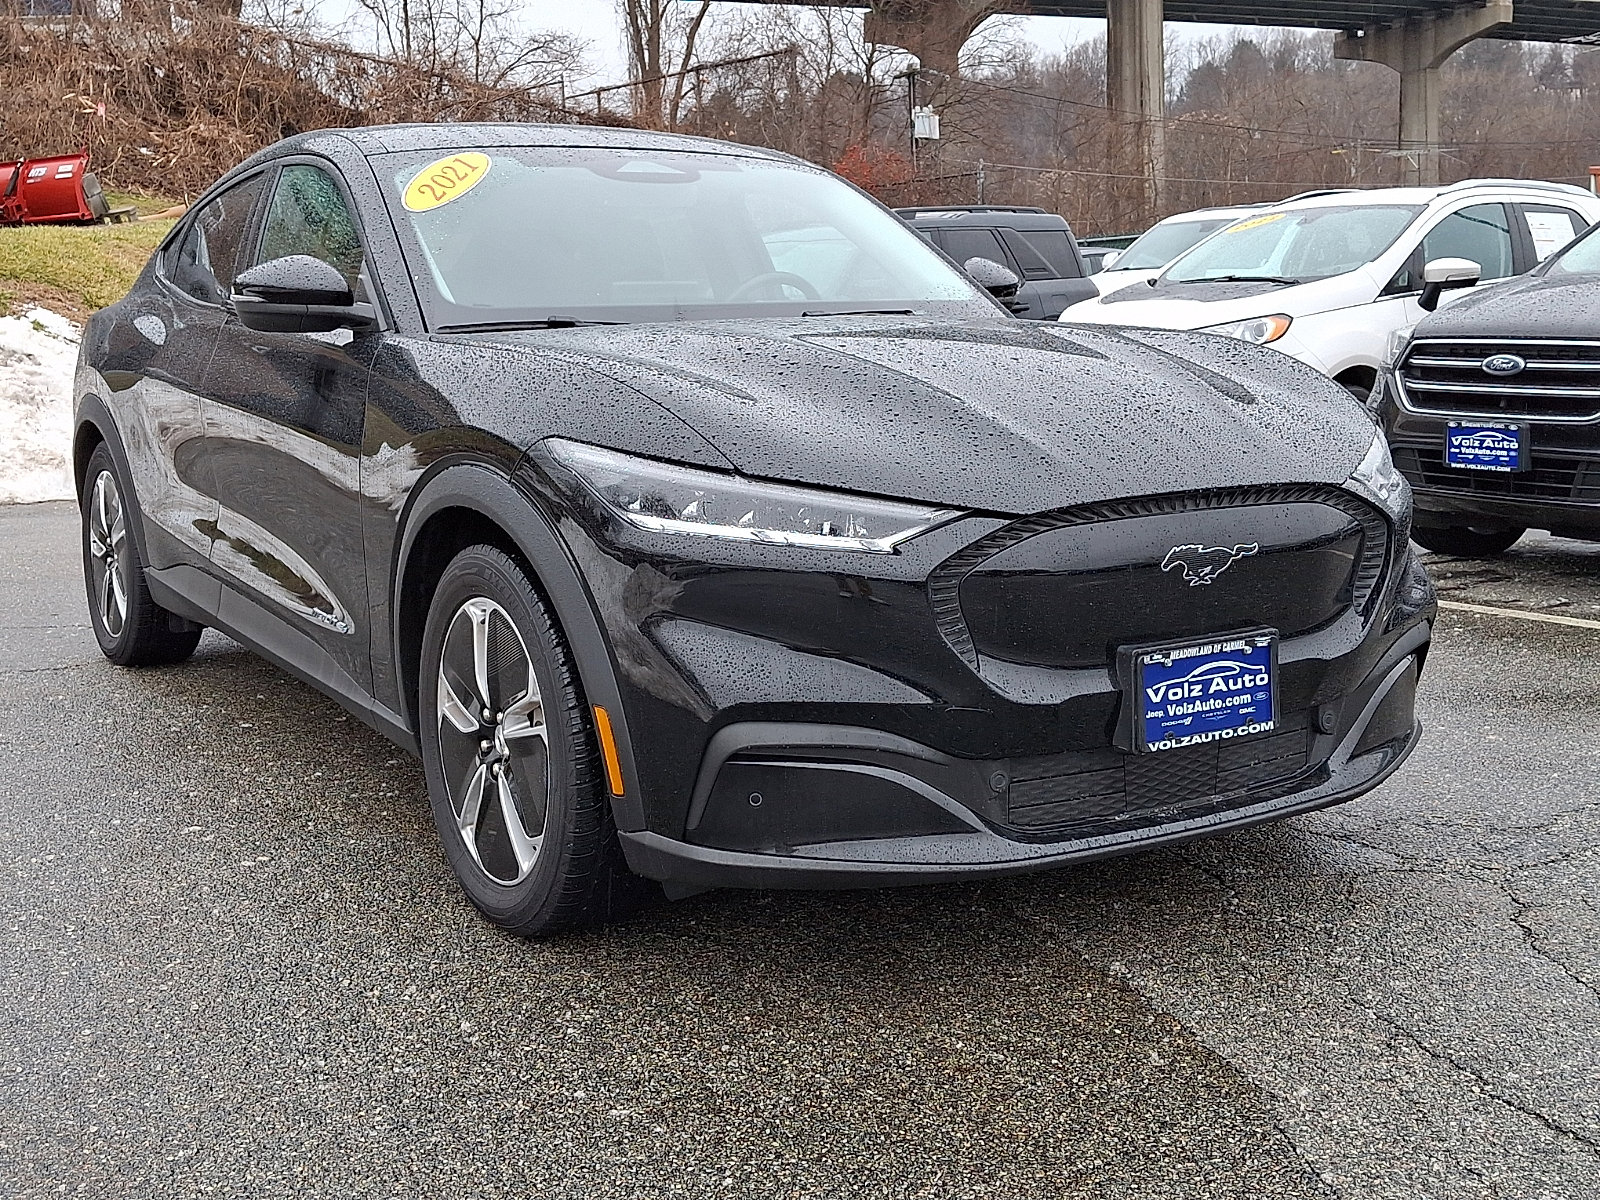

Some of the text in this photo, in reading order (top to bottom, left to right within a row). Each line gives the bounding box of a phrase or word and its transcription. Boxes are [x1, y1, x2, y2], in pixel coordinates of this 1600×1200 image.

[417, 158, 479, 201] 2021
[1490, 358, 1515, 370] Ford
[1451, 436, 1519, 449] Volz Auto
[1460, 447, 1508, 456] VolzAuto.com
[1169, 645, 1213, 660] MEADOWLAND
[1213, 644, 1222, 653] OF
[1222, 640, 1246, 651] CARMEL
[1146, 673, 1269, 703] Volz Auto
[1167, 693, 1252, 716] VolzAuto.com
[1239, 706, 1256, 714] GMC
[1148, 720, 1275, 752] VOLZAUTO.COM
